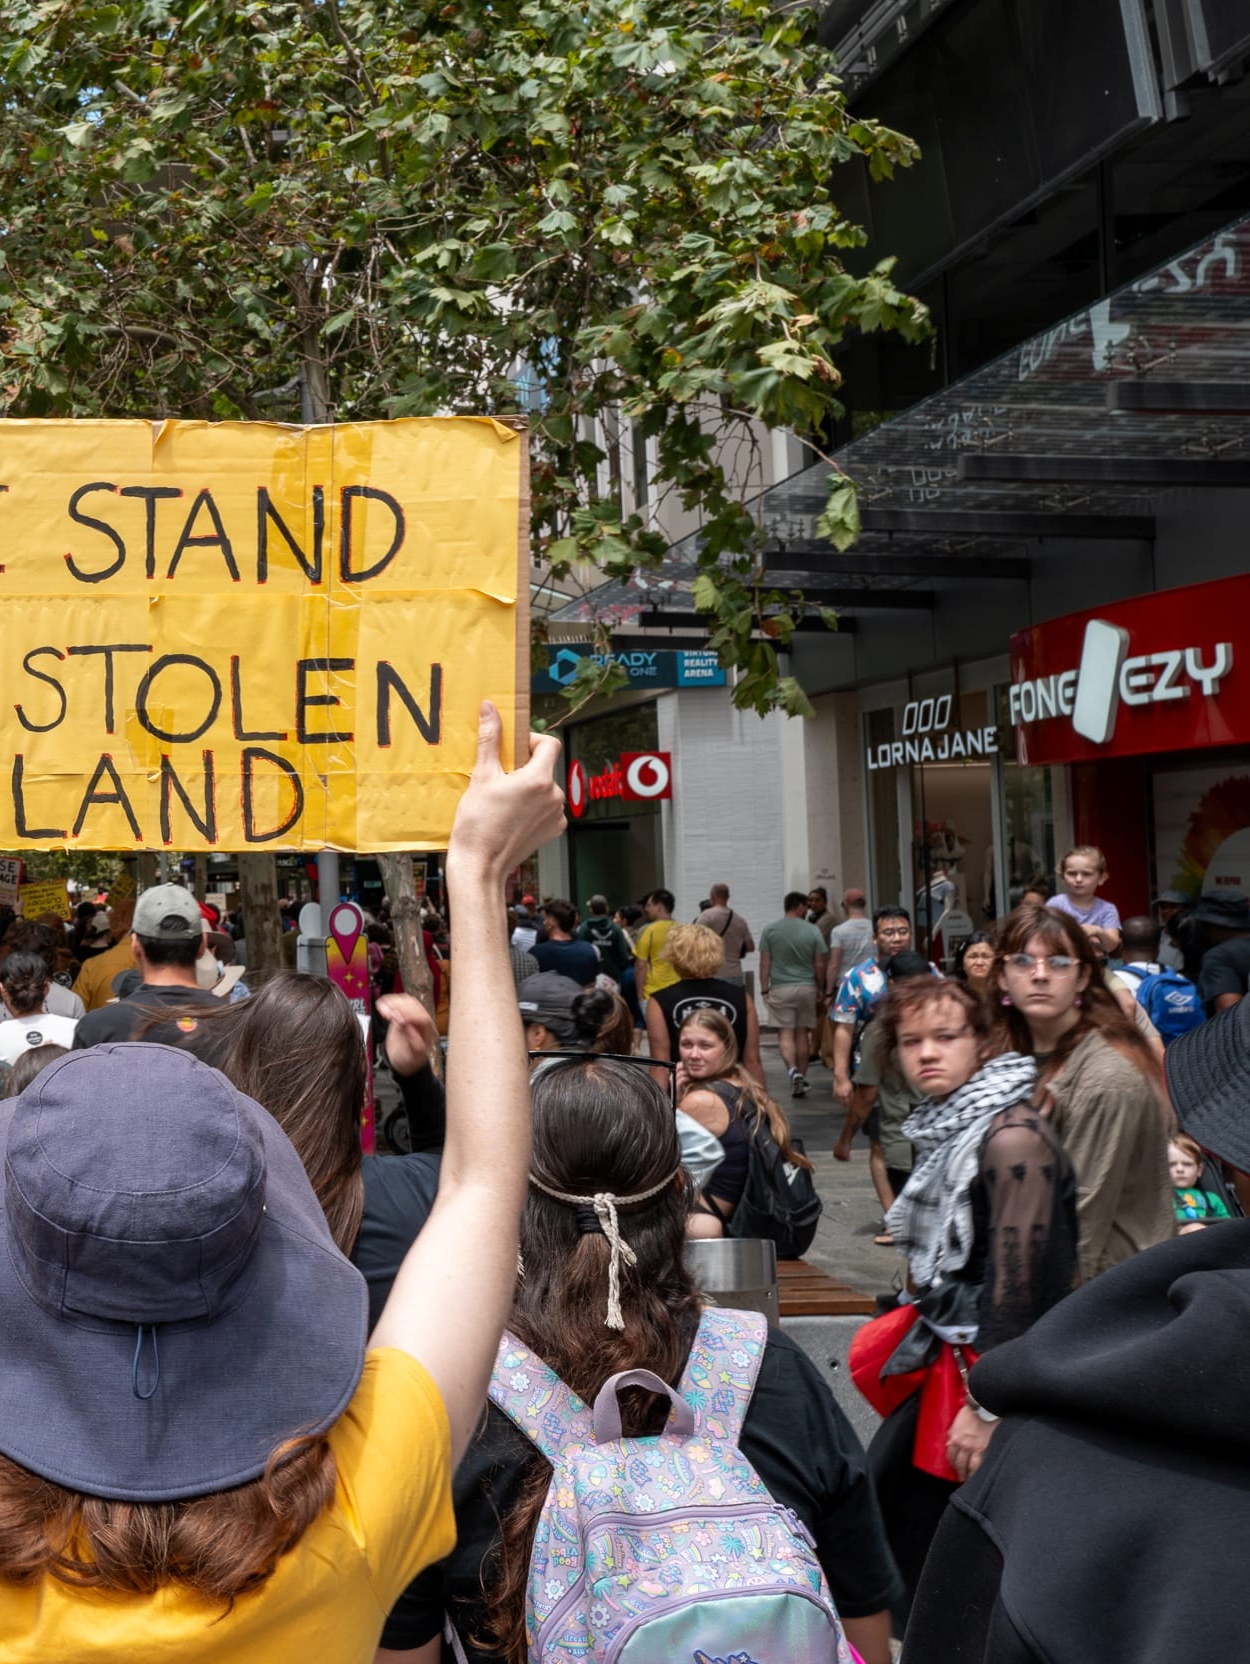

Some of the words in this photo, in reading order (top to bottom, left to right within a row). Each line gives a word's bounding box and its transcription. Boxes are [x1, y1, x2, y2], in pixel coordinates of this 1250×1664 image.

[63, 481, 407, 586] STAND
[629, 666, 658, 677] ONE
[684, 649, 719, 657] VIRTUA
[684, 668, 714, 678] ARENA
[1009, 669, 1081, 727] FONE
[1119, 641, 1234, 706] EZY
[14, 643, 444, 748] STOLEN
[867, 737, 935, 770] LORNA
[936, 725, 999, 760] JANE
[13, 746, 305, 844] LAND
